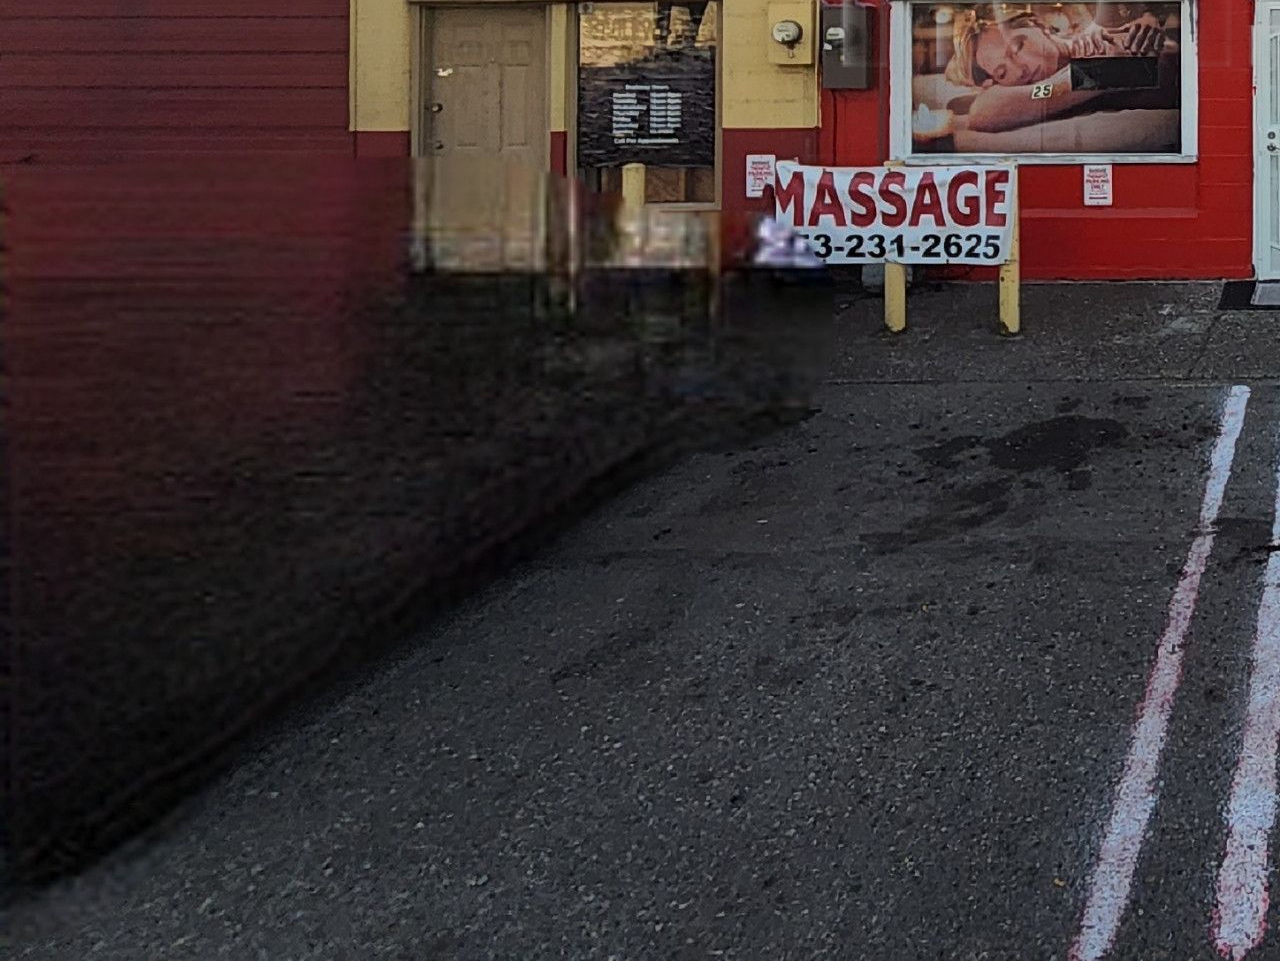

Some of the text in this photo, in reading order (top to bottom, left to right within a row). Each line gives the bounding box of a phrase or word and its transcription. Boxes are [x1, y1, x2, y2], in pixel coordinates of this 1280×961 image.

[1033, 84, 1052, 98] 25
[775, 169, 1010, 227] MASSAGE
[792, 233, 1000, 259] 3-231-2625
